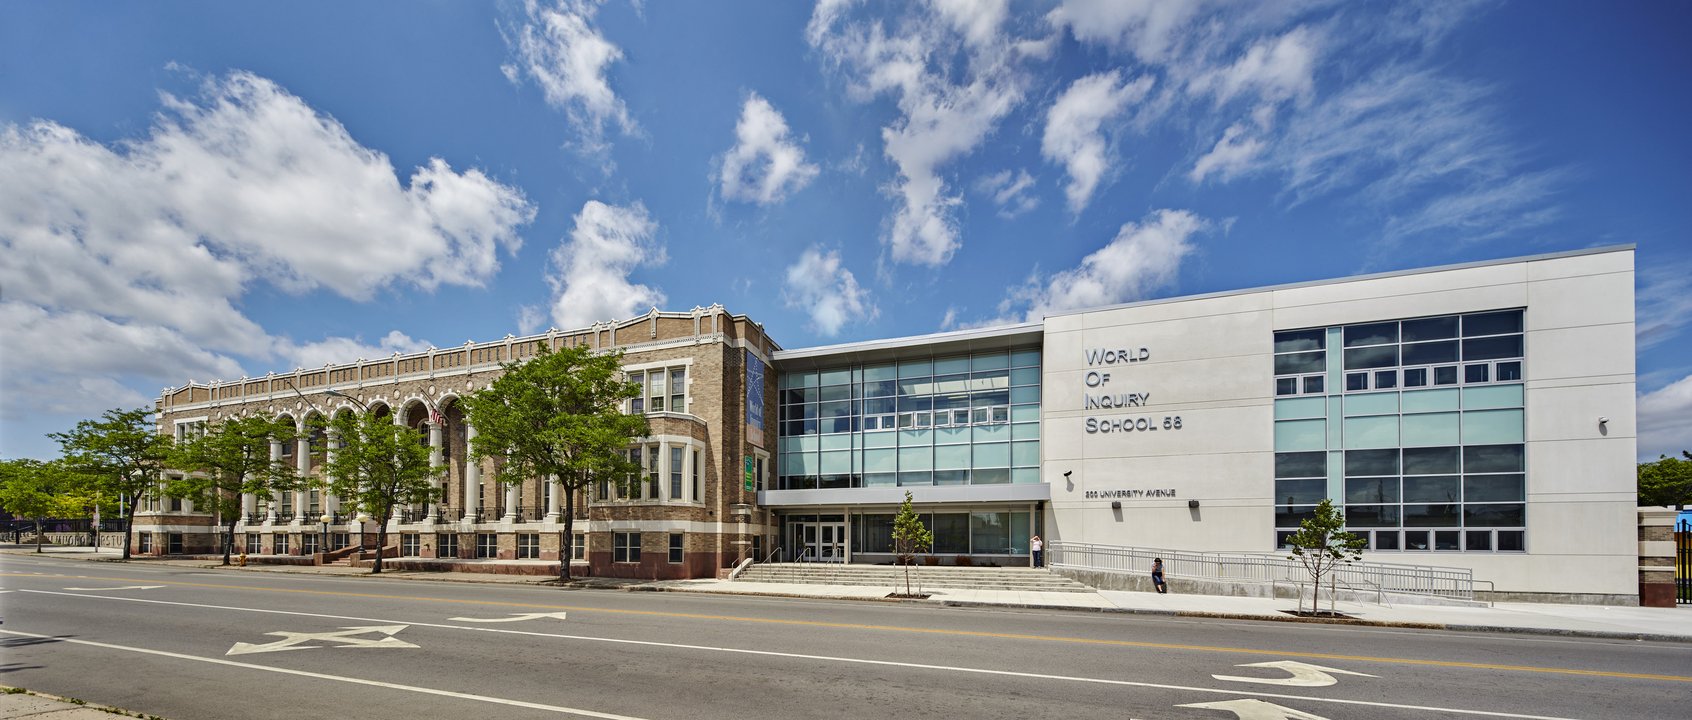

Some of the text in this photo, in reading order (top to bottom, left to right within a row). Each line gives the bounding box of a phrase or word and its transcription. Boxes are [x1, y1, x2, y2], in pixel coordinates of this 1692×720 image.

[1085, 348, 1150, 365] WORLD
[1085, 371, 1111, 388] OF
[1085, 392, 1150, 410] INQUIRY
[1085, 416, 1183, 434] SCHOOL 58
[1100, 489, 1144, 498] UNIVERSITY
[1146, 488, 1176, 498] AVENUE
